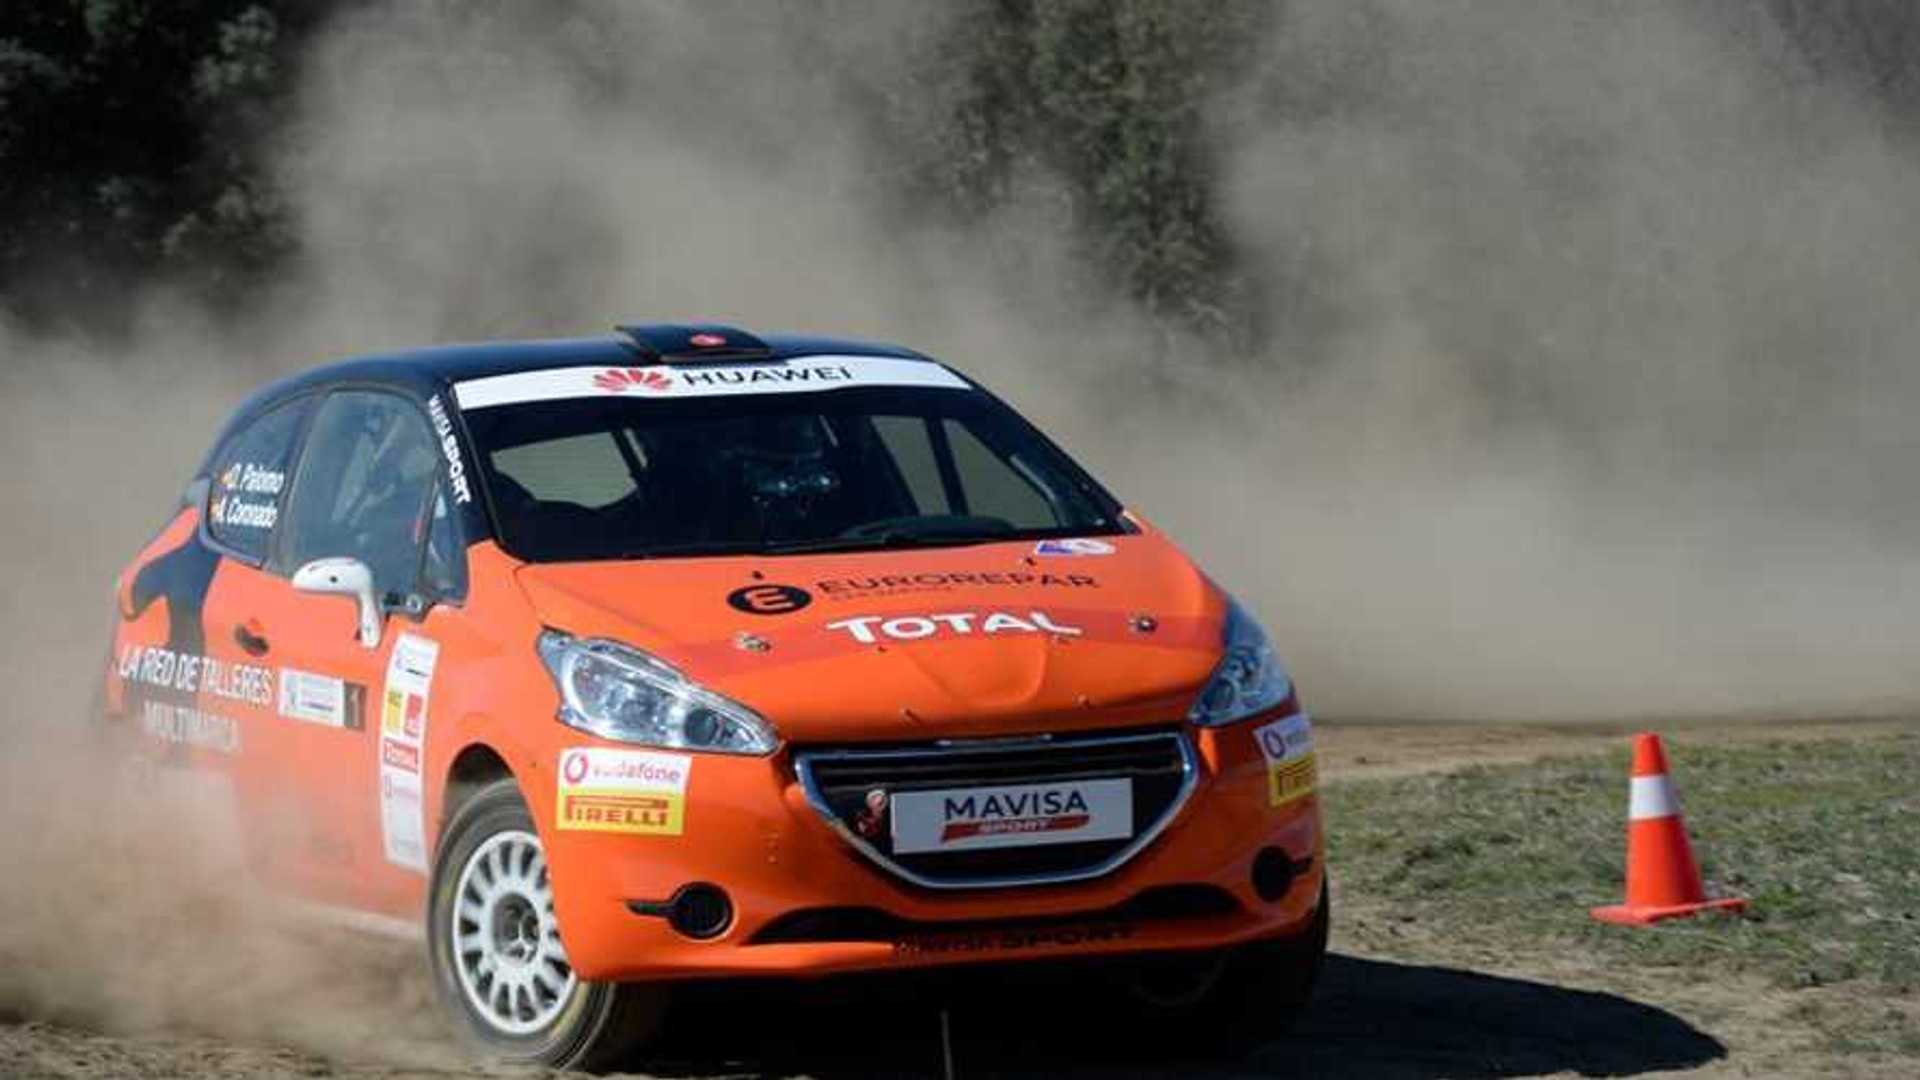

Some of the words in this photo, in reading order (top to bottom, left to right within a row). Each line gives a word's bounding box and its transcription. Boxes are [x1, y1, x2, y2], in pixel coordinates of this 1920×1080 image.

[683, 366, 852, 385] HUAWEI
[240, 463, 284, 494] Palomo
[227, 497, 278, 528] Coronado
[817, 573, 1101, 593] EUROREPAR
[827, 611, 1083, 643] TOTAL
[141, 648, 175, 687] RED
[176, 653, 200, 692] DE
[202, 656, 273, 704] TALLERES
[565, 795, 669, 826] PIRELLI
[944, 789, 1088, 819] MAVISA
[977, 819, 1050, 833] SPORT
